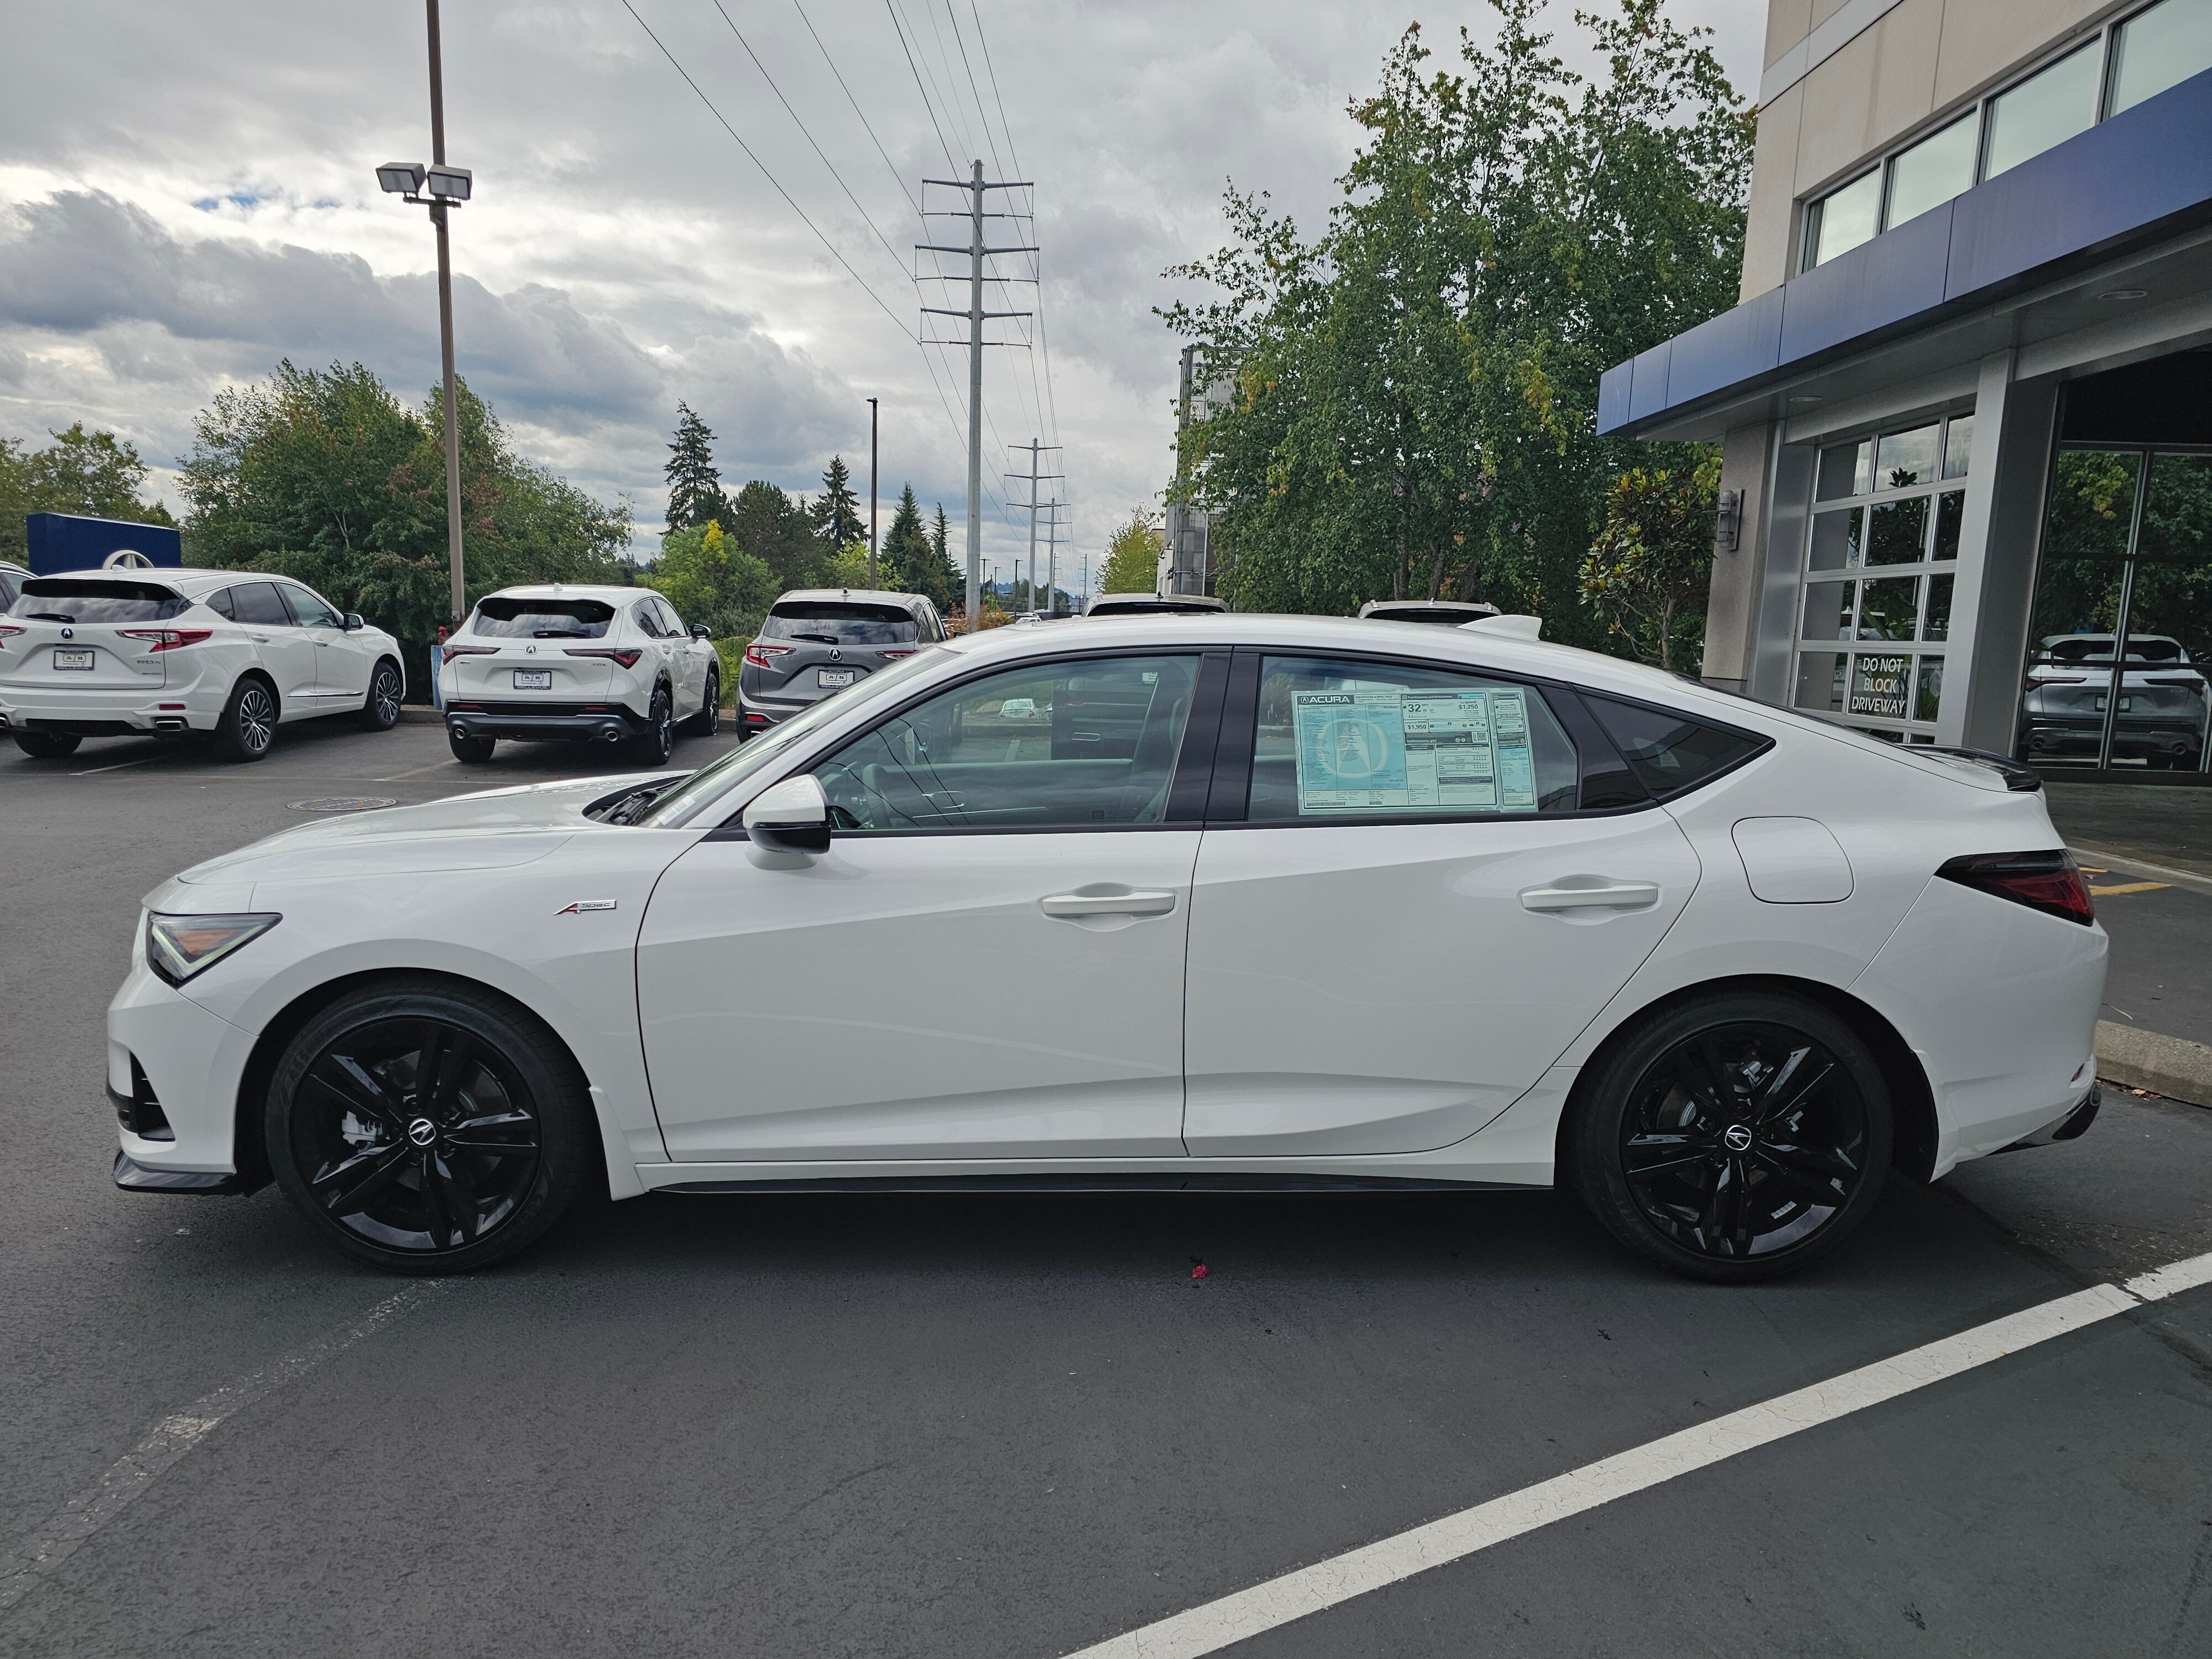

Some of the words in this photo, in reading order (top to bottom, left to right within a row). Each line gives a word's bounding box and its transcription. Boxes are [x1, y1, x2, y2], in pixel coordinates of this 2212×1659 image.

[1863, 658, 1878, 671] DO
[1880, 658, 1903, 672] NOT
[1864, 678, 1897, 693] BLOCK
[1408, 704, 1422, 712] 32
[1851, 696, 1905, 713] DRIVEWAY
